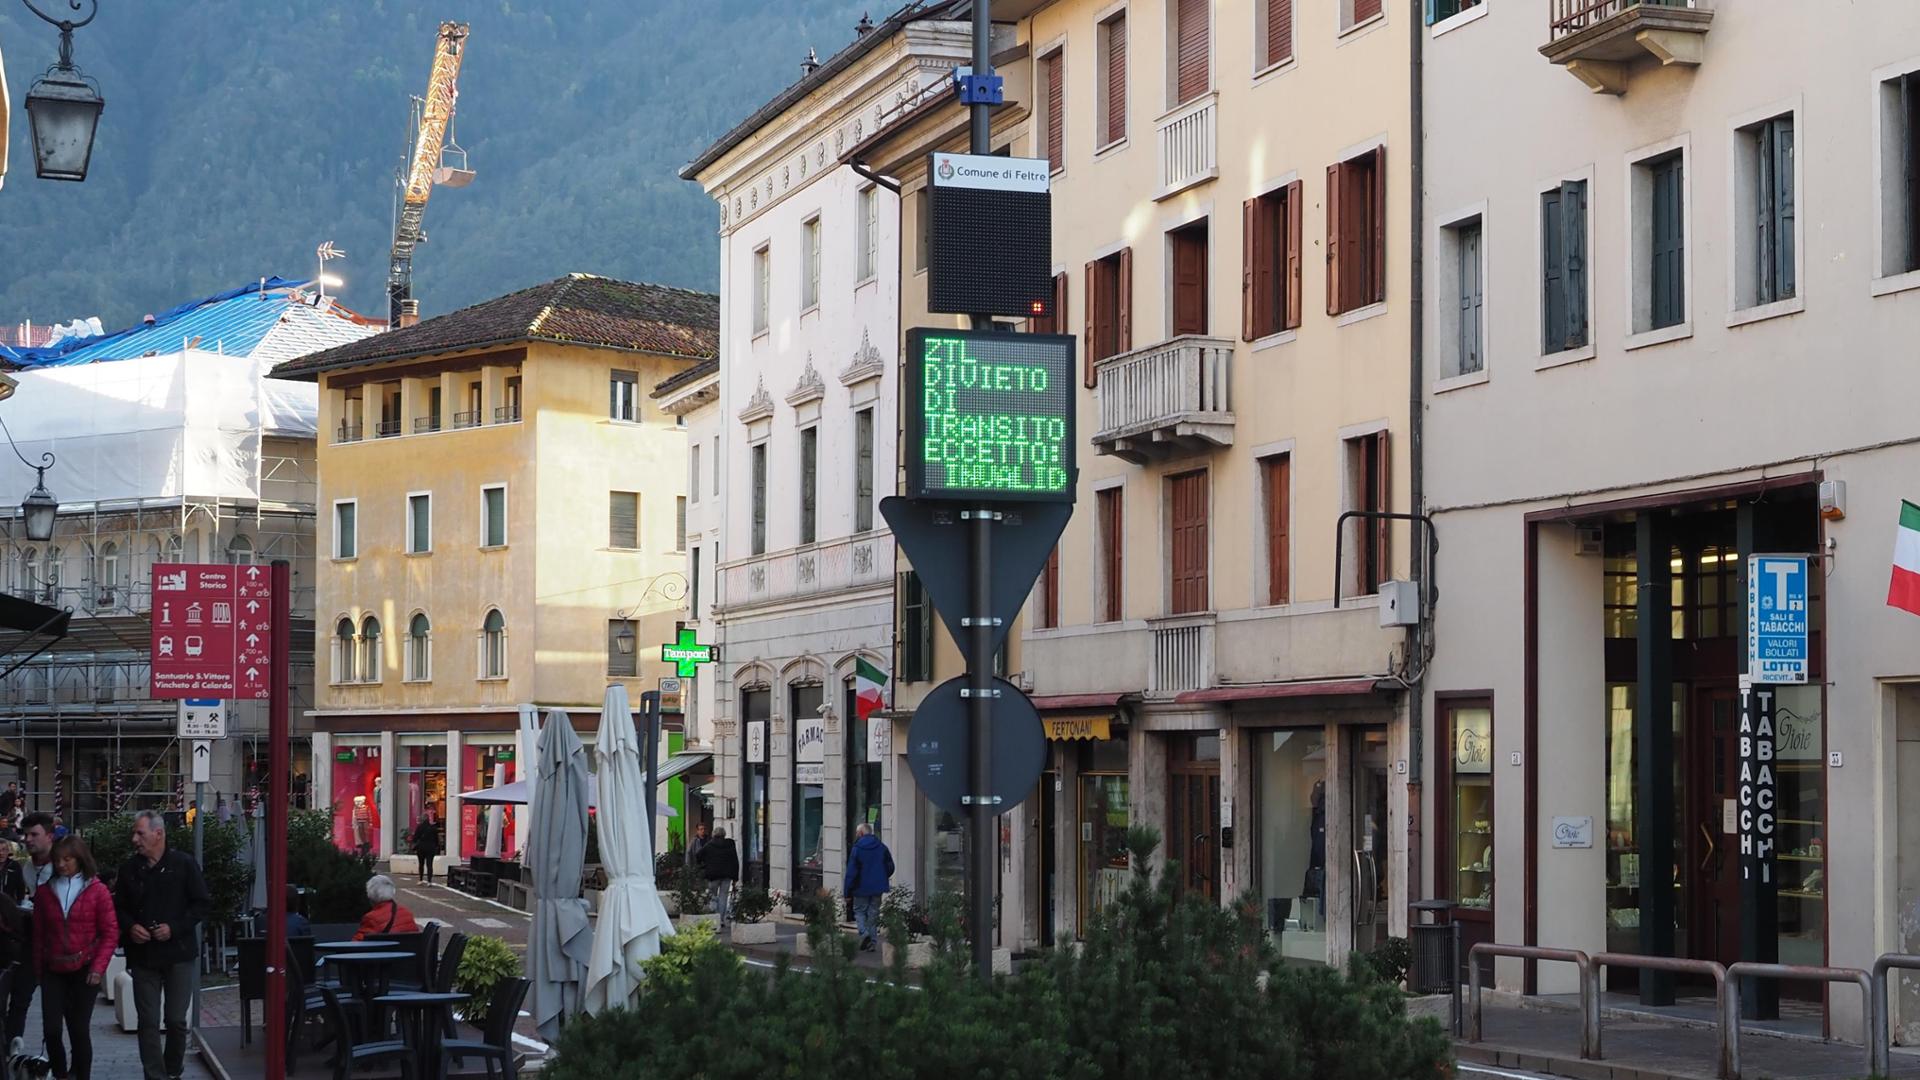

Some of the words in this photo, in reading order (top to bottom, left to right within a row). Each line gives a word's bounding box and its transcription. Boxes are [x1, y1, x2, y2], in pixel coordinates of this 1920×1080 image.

[957, 166, 999, 178] Comune
[1002, 169, 1012, 179] di
[1015, 170, 1046, 181] Feltre
[925, 338, 976, 363] ZTL
[925, 363, 1047, 391] DIVIETO
[925, 388, 956, 412] DI
[925, 413, 1065, 441] TRANSITO
[925, 438, 1058, 464] ECCETTO:
[200, 572, 226, 580] Centro
[1770, 613, 1787, 621] SALI
[1788, 613, 1794, 621] E
[1760, 621, 1804, 633] TABACCHI
[1767, 639, 1797, 647] VALORI
[1765, 648, 1798, 657] BOLLATI
[1763, 661, 1801, 671] LOTTO
[155, 672, 194, 680] Santuario
[1052, 720, 1092, 736] FERTONANI
[1777, 716, 1812, 752] Gioie
